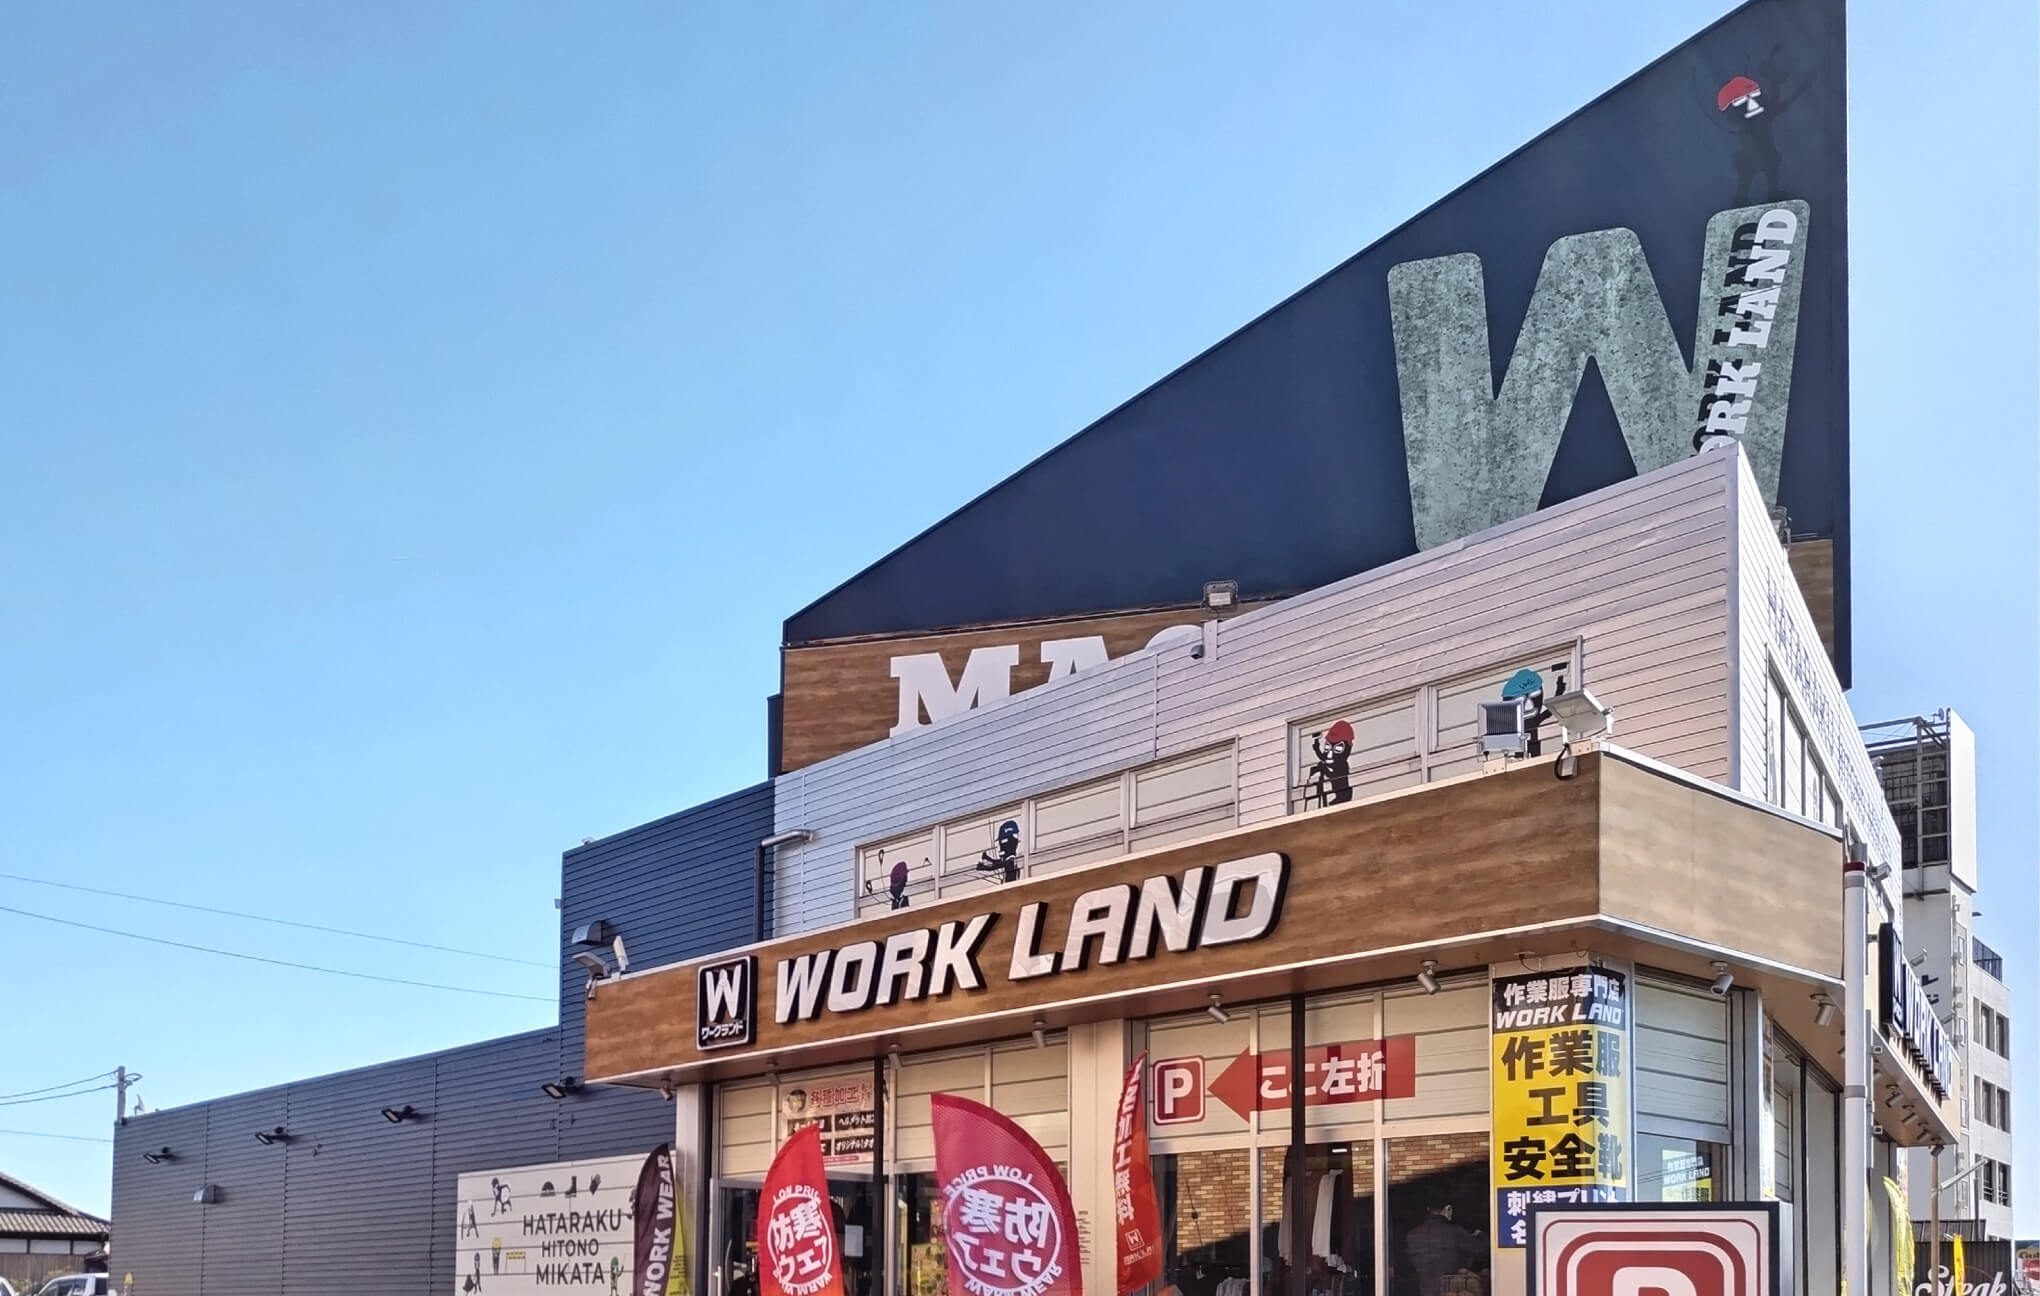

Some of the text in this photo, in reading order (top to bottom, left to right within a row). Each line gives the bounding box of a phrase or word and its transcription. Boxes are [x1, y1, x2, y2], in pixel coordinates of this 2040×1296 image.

[1728, 208, 1798, 348] LAND
[774, 851, 1290, 1025] WORK LAND
[705, 964, 742, 1022] W
[1503, 974, 1621, 1007] 作業服専門店
[701, 1020, 744, 1040] ワークランド
[1496, 1002, 1622, 1029] WORK LAND
[1501, 1029, 1621, 1081] 作業服
[1164, 1068, 1193, 1114] P
[1526, 1081, 1609, 1127] 工具
[1503, 1133, 1622, 1182] 安全靴
[656, 1155, 673, 1220] WEAR
[523, 1208, 622, 1236] HATARAKU
[772, 1199, 823, 1255] 防寒
[542, 1238, 599, 1258] HITONO
[536, 1262, 605, 1286] MIKATA
